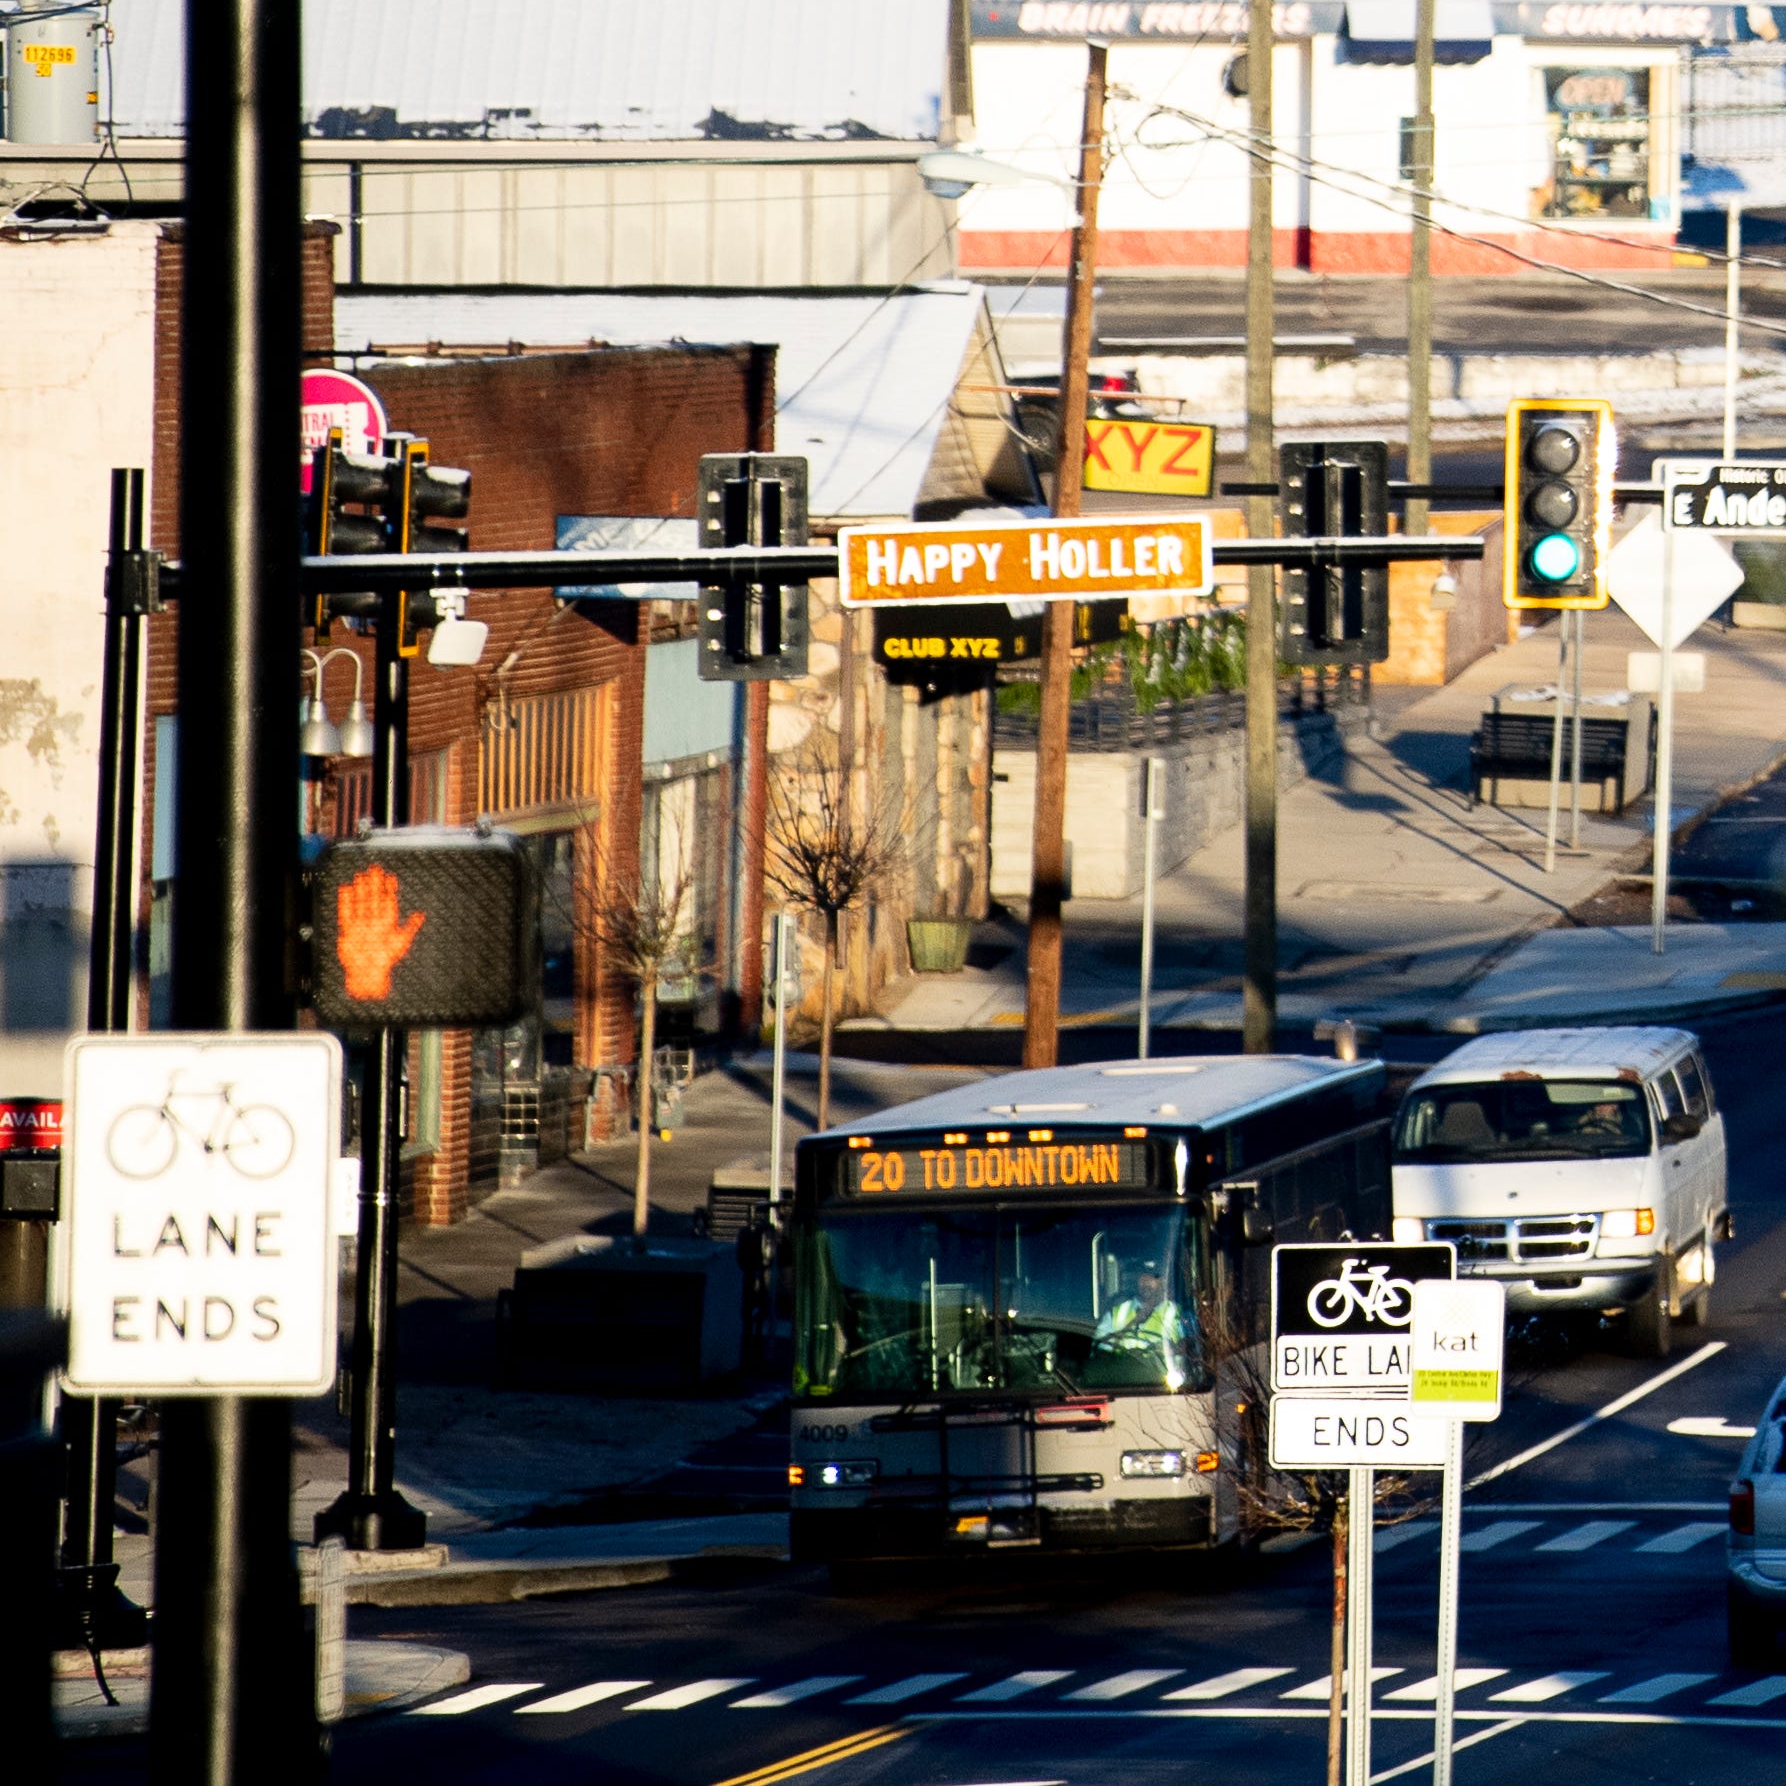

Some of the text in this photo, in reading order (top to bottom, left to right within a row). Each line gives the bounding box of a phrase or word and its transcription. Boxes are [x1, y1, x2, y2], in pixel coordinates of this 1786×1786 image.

[1018, 0, 1132, 34] BRAIN
[1082, 424, 1202, 476] XYZ
[1674, 491, 1694, 526] E
[867, 533, 1184, 587] HAPPY HOLLER
[883, 637, 947, 659] CLUB
[950, 637, 1000, 658] XYZ
[0, 1111, 63, 1128] AVAIL
[860, 1143, 1121, 1192] 20 TO DOWNTOWN
[113, 1211, 284, 1259] LANE
[111, 1294, 282, 1342] ENDS
[1432, 1330, 1479, 1352] kat
[1283, 1343, 1412, 1379] BIKE LA
[799, 1423, 848, 1443] 4009
[1313, 1415, 1410, 1447] ENDS
